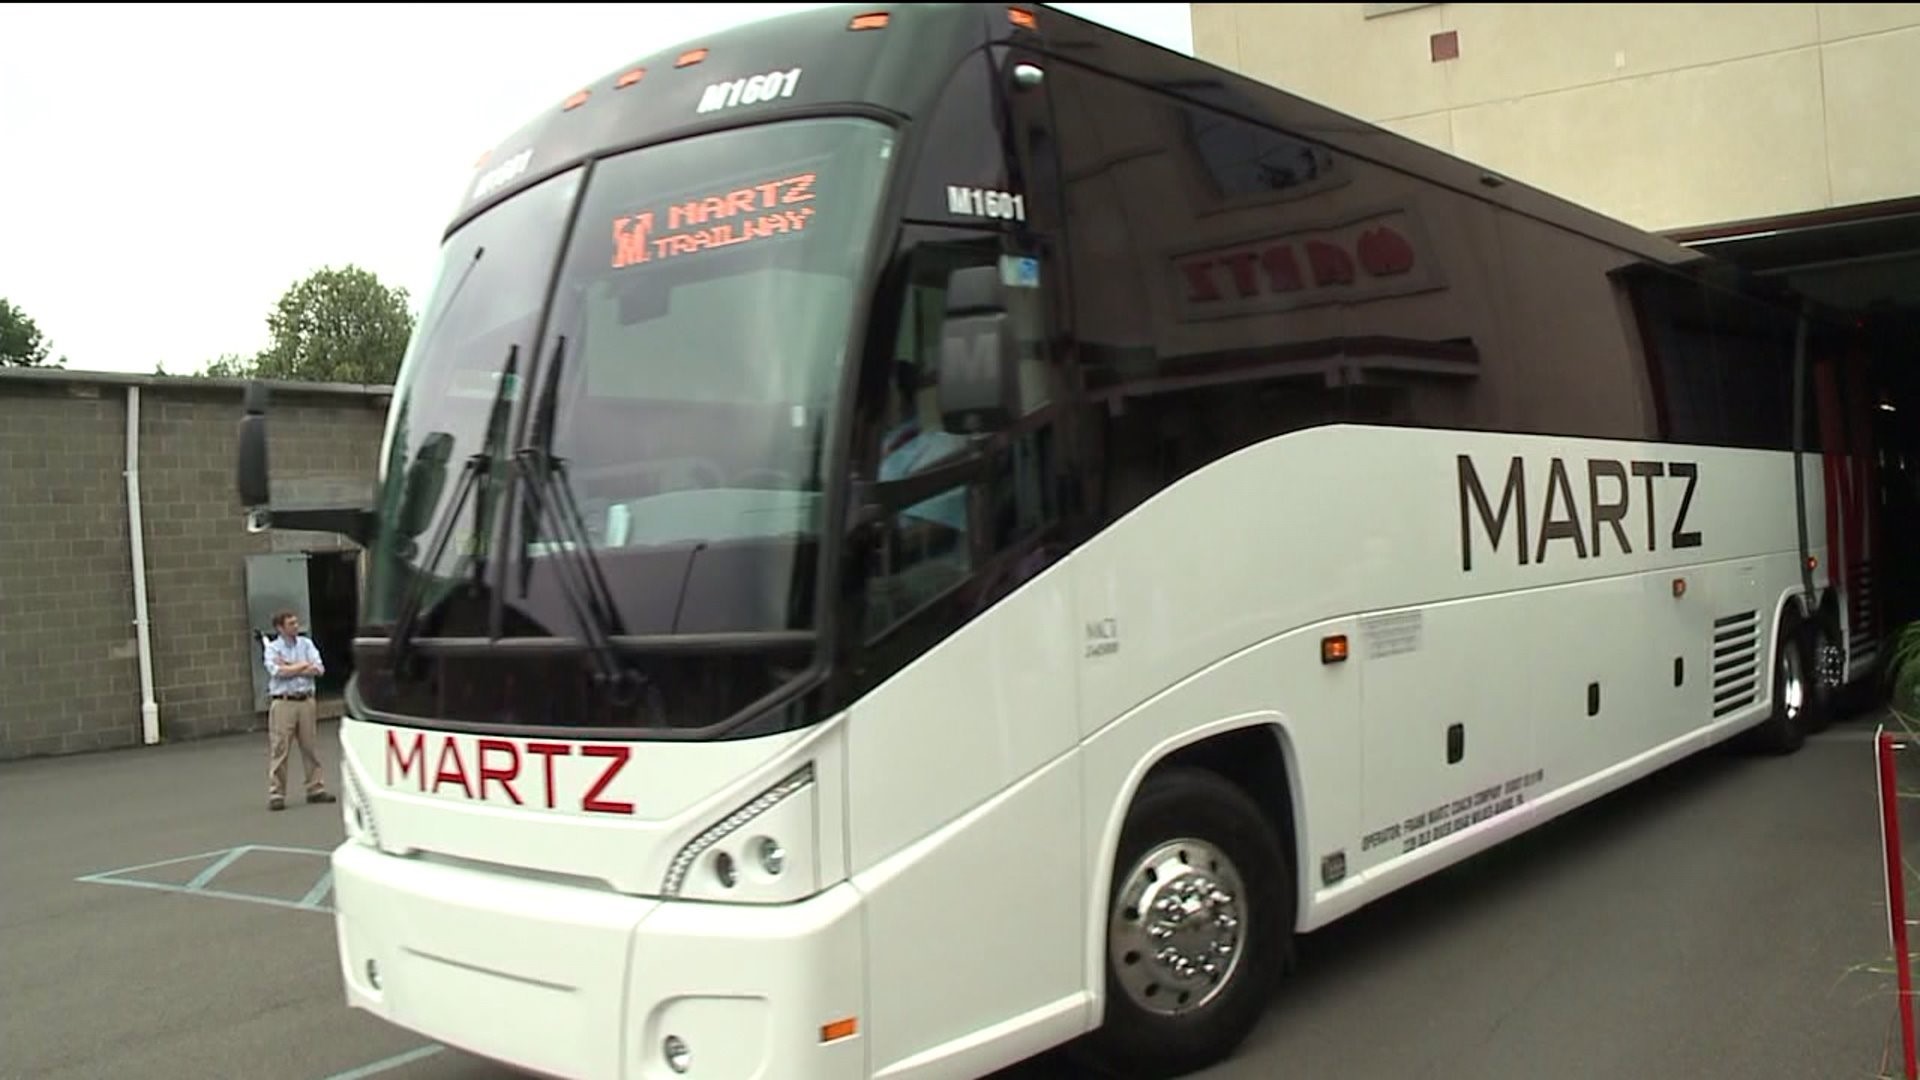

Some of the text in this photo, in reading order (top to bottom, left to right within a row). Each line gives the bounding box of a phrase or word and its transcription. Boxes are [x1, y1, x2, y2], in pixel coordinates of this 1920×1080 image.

[697, 68, 802, 113] M1601
[667, 173, 816, 229] MARTZ
[948, 186, 1026, 221] M1601
[1457, 454, 1702, 571] MARTZ
[386, 730, 634, 814] MARTZ
